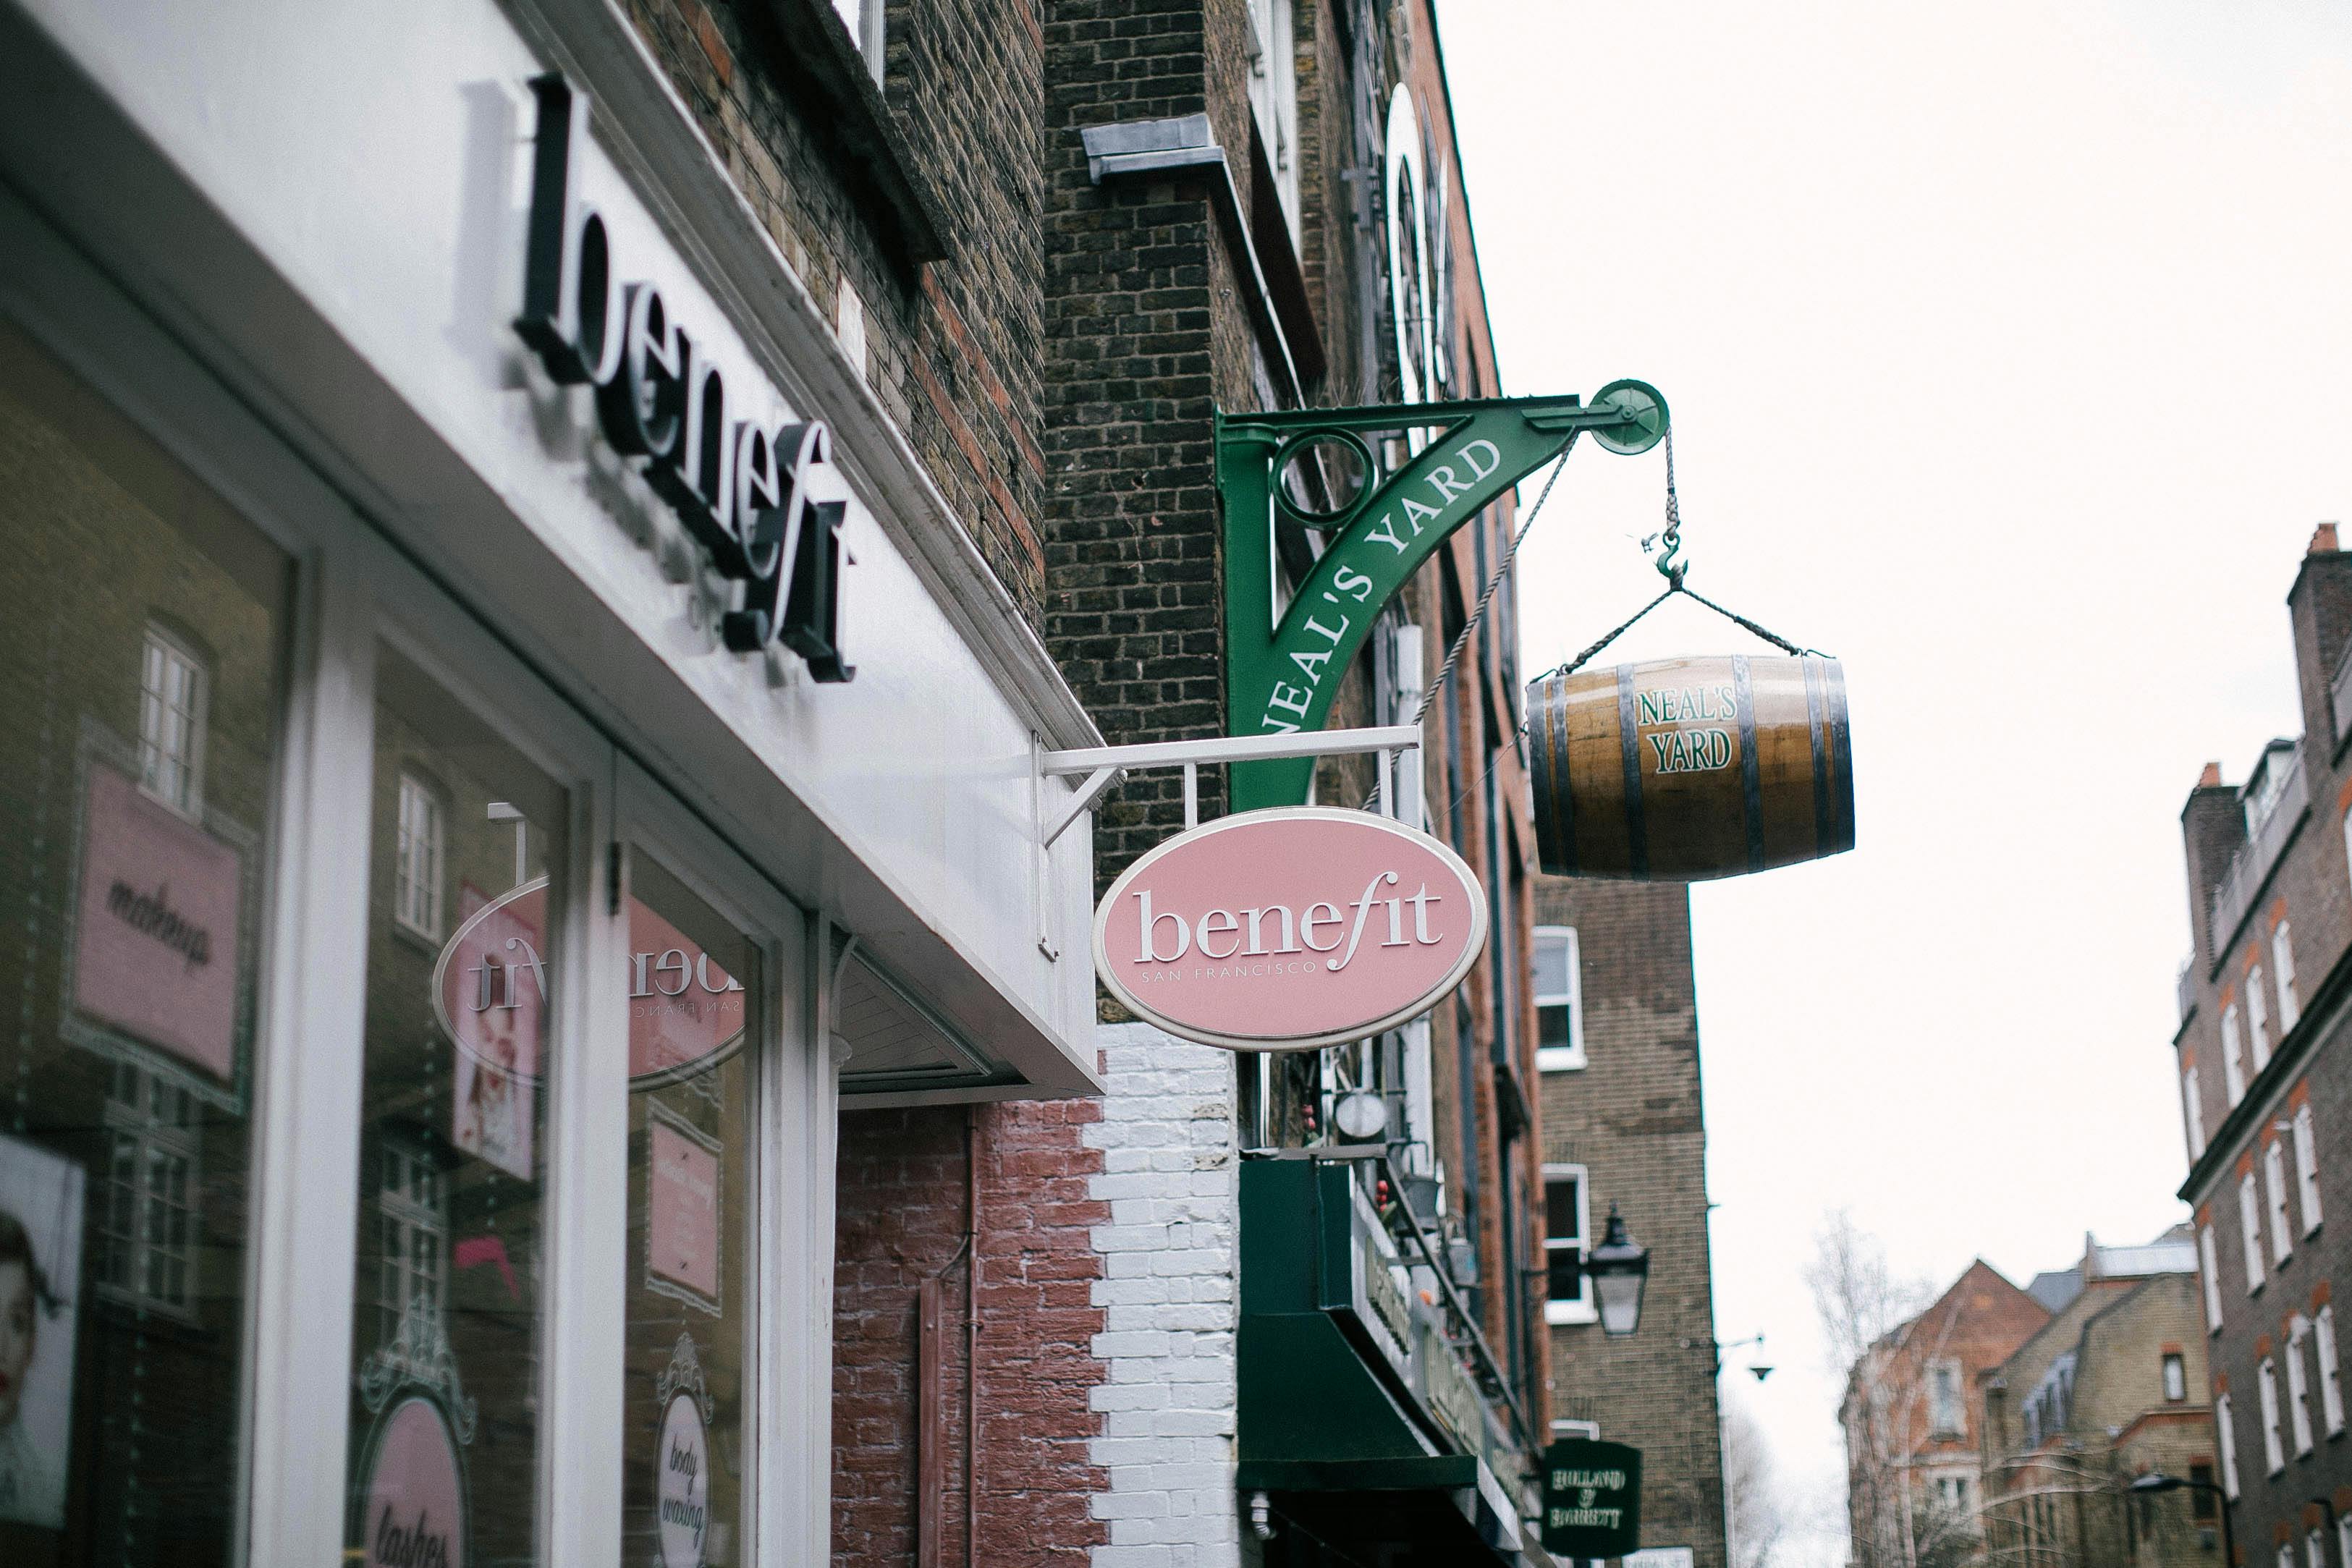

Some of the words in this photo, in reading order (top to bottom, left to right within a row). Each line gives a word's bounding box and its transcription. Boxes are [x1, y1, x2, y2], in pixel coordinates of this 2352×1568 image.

[1363, 438, 1501, 555] YARD
[1638, 686, 1738, 726] NEAL'S
[1646, 727, 1732, 774] YARD
[1132, 870, 1444, 972] benefit
[1141, 970, 1181, 983] SAN
[1194, 961, 1316, 979] FRANCISCO
[670, 1433, 698, 1496] body
[663, 1497, 704, 1549] waxing
